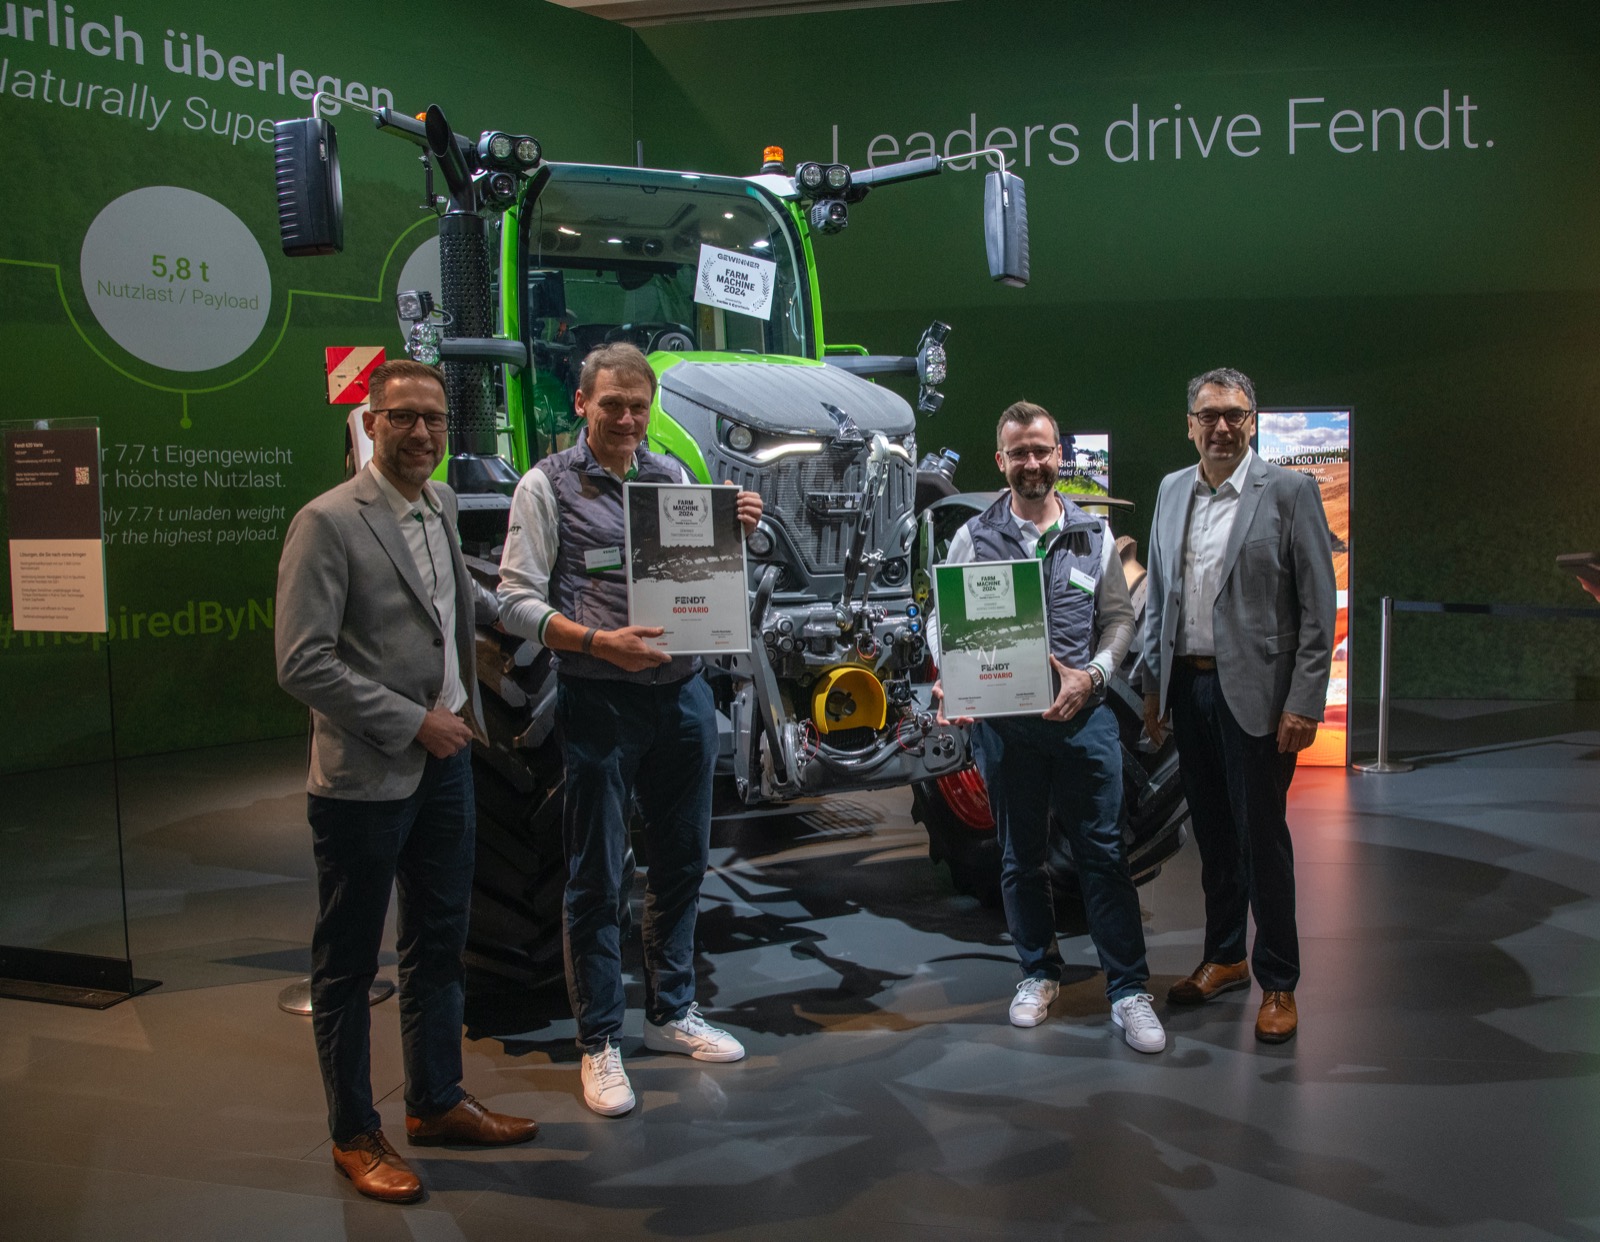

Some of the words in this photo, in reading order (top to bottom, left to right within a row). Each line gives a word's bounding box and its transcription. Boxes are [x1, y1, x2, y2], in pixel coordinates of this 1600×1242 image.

[164, 29, 394, 116] überlegen
[1104, 103, 1262, 163] drive
[1288, 89, 1494, 155] Fendt.
[152, 254, 191, 282] 5,8
[199, 261, 209, 282] t
[717, 253, 760, 269] GEWINNER
[716, 274, 755, 291] MACHINE
[725, 268, 749, 281] FARM
[97, 279, 174, 302] Nutzlast
[193, 289, 259, 310] Payload
[724, 285, 746, 297] 2024
[115, 444, 145, 464] 7,7
[152, 446, 160, 462] t
[166, 445, 293, 467] Eigengewicht
[1059, 458, 1105, 468] Sichtinkel
[1315, 455, 1343, 465] U/min
[116, 469, 198, 488] höchste
[204, 469, 286, 488] Nutzlast.
[1058, 468, 1073, 477] field
[128, 506, 153, 521] 7.7
[158, 507, 164, 521] t
[169, 505, 231, 521] unladen
[236, 504, 286, 523] weight
[122, 529, 148, 544] the
[153, 528, 213, 547] highest
[216, 525, 279, 545] payload.
[674, 596, 706, 605] FENDT
[672, 606, 687, 614] 600
[688, 606, 709, 614] VARIO
[981, 662, 1010, 672] FENDT
